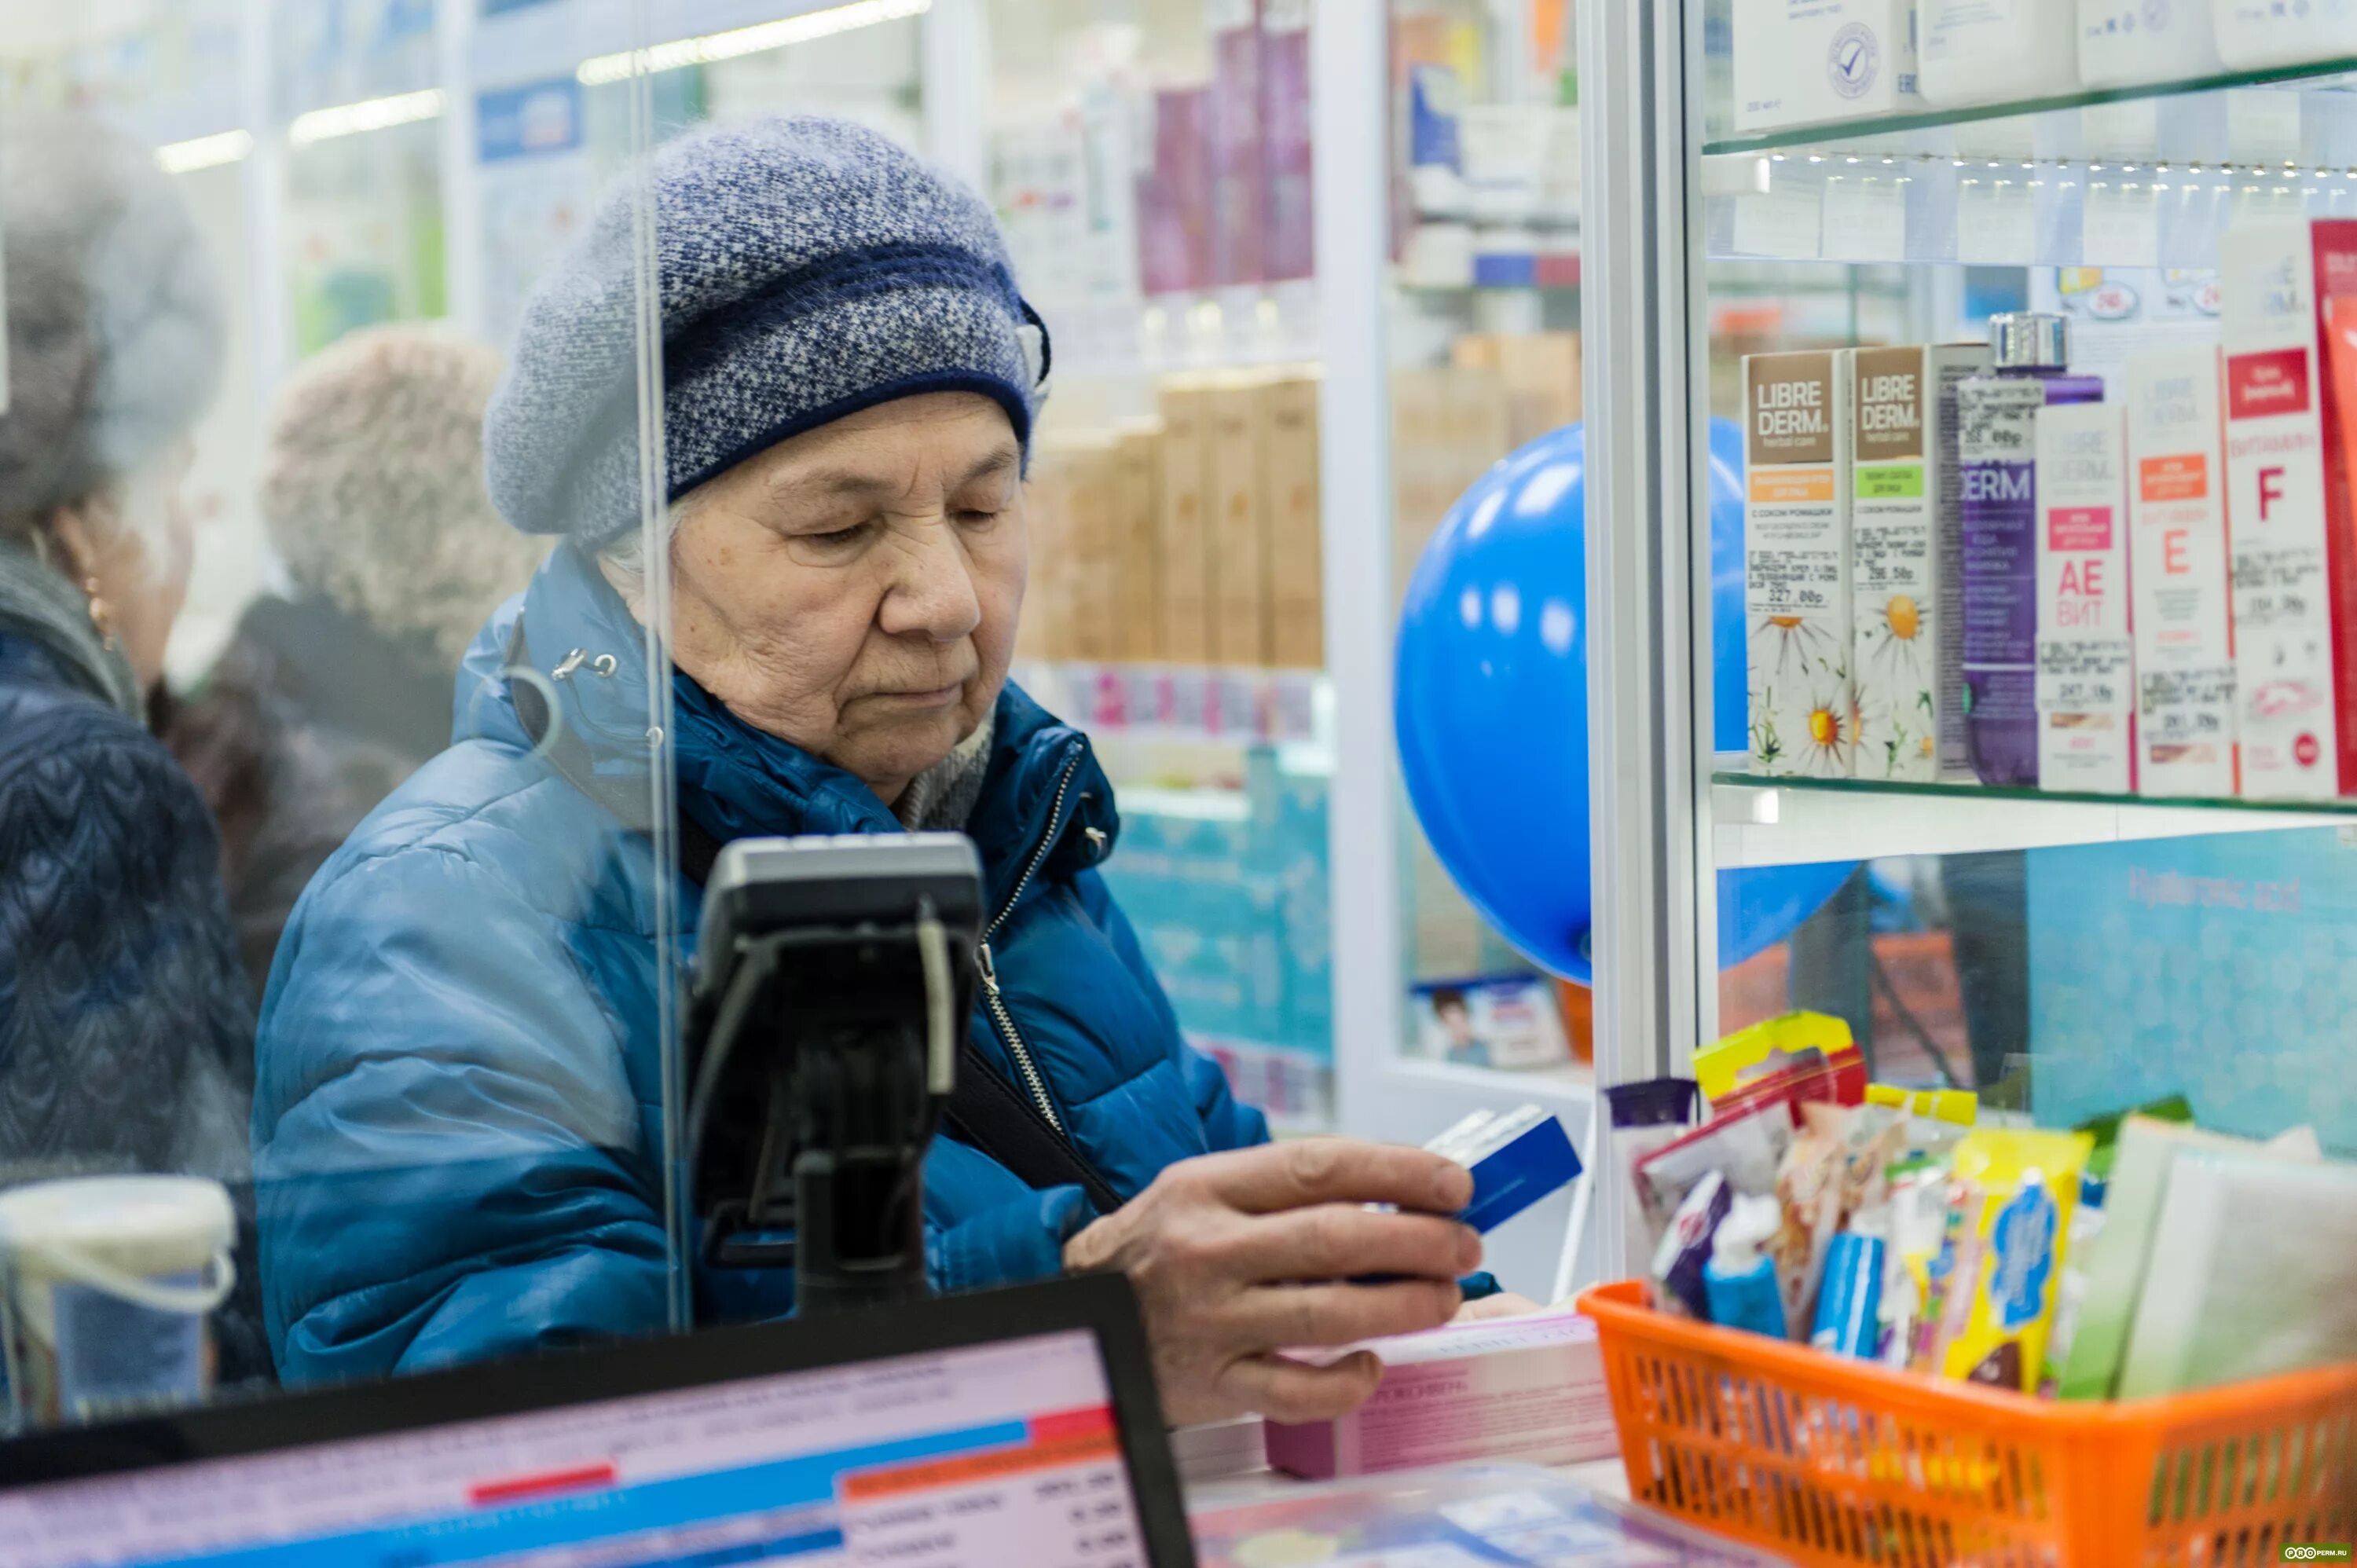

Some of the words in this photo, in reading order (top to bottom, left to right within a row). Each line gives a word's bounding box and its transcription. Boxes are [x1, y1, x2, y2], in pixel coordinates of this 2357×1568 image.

[1757, 380, 1822, 408] LIBRE
[1860, 374, 1915, 402] LIBRE
[2259, 467, 2285, 523] F
[2164, 529, 2190, 575] E
[2057, 599, 2105, 627] ВИТ
